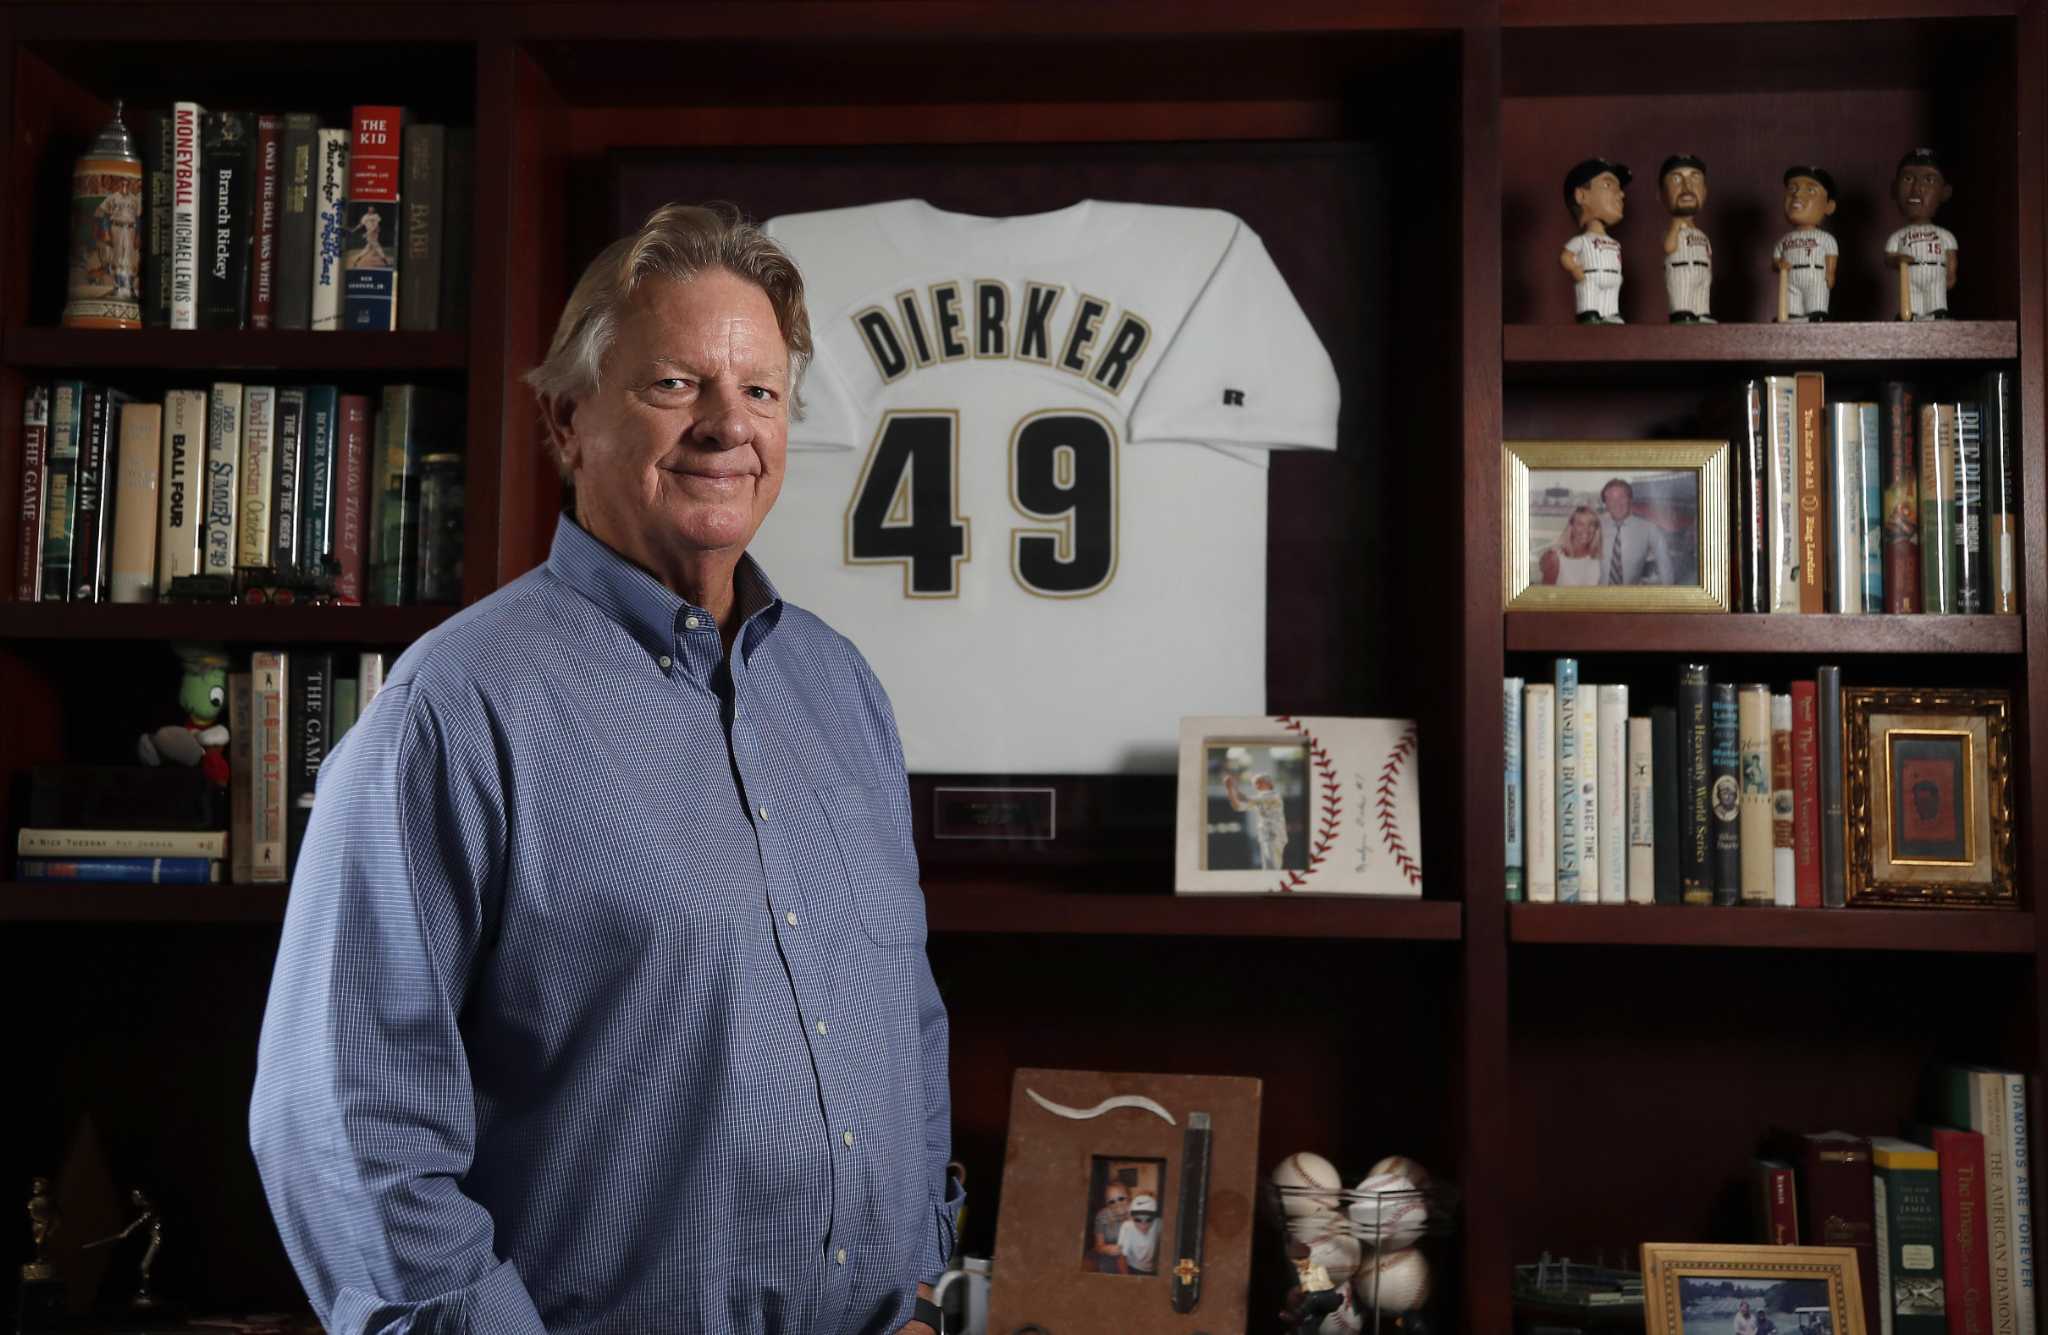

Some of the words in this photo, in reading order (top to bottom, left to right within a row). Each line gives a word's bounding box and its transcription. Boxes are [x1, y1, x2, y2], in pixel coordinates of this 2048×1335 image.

[360, 133, 387, 145] KID
[361, 119, 387, 131] THE
[176, 110, 194, 206] MONEYBALL
[263, 141, 277, 172] ONLY
[323, 141, 339, 203] Durocher
[218, 168, 233, 225] Branch
[262, 175, 275, 200] THE
[261, 201, 274, 232] BALL
[174, 213, 192, 264] MICHAEL
[212, 229, 231, 280] Rickey
[260, 234, 273, 259] WAS
[174, 267, 191, 303] LEWIS
[258, 260, 272, 303] WHITE
[850, 279, 1152, 397] DIERKER
[211, 389, 223, 451] HALBERSTAM
[223, 405, 235, 433] DAVID
[249, 392, 269, 425] David
[283, 415, 296, 437] THE
[1804, 408, 1813, 428] You
[25, 428, 40, 465] THE
[281, 438, 295, 471] HEART
[314, 411, 327, 459] ROGER
[1804, 430, 1813, 459] Know
[172, 433, 186, 478] BALL
[247, 428, 267, 495] Halberstam
[347, 432, 361, 492] SEASON
[1804, 461, 1813, 475] Me
[23, 470, 38, 521] GAME
[81, 470, 97, 511] ZIM
[208, 460, 233, 529] SUMMER
[280, 491, 292, 512] THE
[281, 474, 294, 490] OF
[313, 461, 326, 511] ANGELL
[170, 481, 184, 528] FOUR
[246, 500, 264, 546] October
[843, 407, 1120, 600] 49
[211, 530, 228, 548] OF
[278, 514, 292, 548] ORDER
[344, 497, 359, 554] TICKET
[1804, 516, 1814, 541] Ring
[1806, 543, 1816, 586] Lardner
[306, 672, 323, 712] THE
[1694, 704, 1703, 720] The
[304, 719, 322, 777] GAME
[1562, 698, 1575, 761] KINSELLA
[1694, 724, 1706, 781] Heavenly
[1562, 766, 1575, 798] BOX
[1584, 799, 1594, 832] MAGIC
[1695, 785, 1707, 821] World
[1562, 802, 1576, 869] SOCIALS
[1584, 836, 1594, 861] TIME
[1695, 825, 1707, 863] Series
[2011, 1084, 2029, 1168] DIAMONDS
[1957, 1167, 1975, 1198] The
[1990, 1152, 2003, 1177] THE
[2017, 1176, 2031, 1206] ARE
[1955, 1201, 1976, 1249] Image
[1992, 1179, 2008, 1261] AMERICAN
[2019, 1214, 2033, 1289] FOREVER
